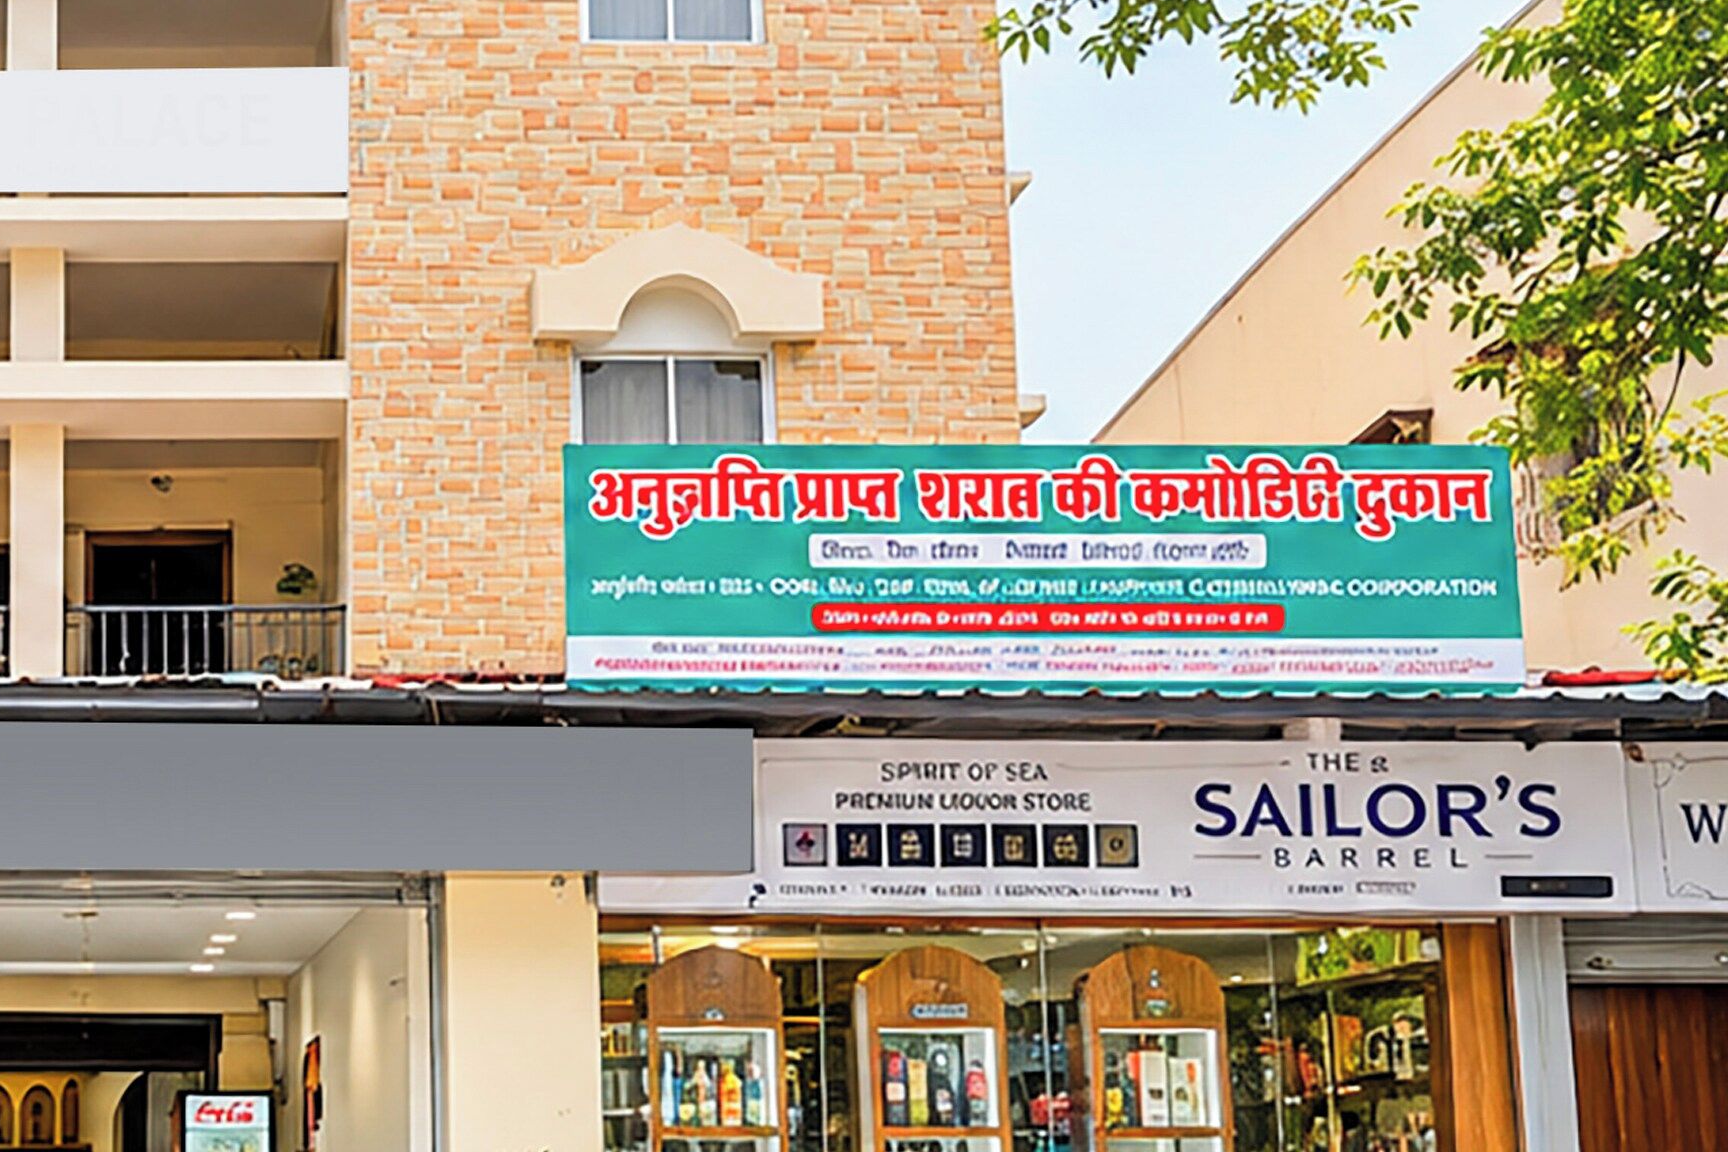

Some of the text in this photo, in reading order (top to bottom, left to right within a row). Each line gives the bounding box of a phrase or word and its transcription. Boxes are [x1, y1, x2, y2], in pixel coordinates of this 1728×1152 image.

[794, 472, 900, 519] प्राप्त
[1051, 457, 1120, 519] की
[1351, 472, 1489, 538] दुकान
[880, 761, 962, 782] SPIRIT
[1005, 761, 1049, 782] SEA
[1306, 752, 1360, 772] THE
[1022, 791, 1092, 812] STORE
[1194, 774, 1562, 838] SAILOR'S
[1273, 847, 1468, 869] BARREL
